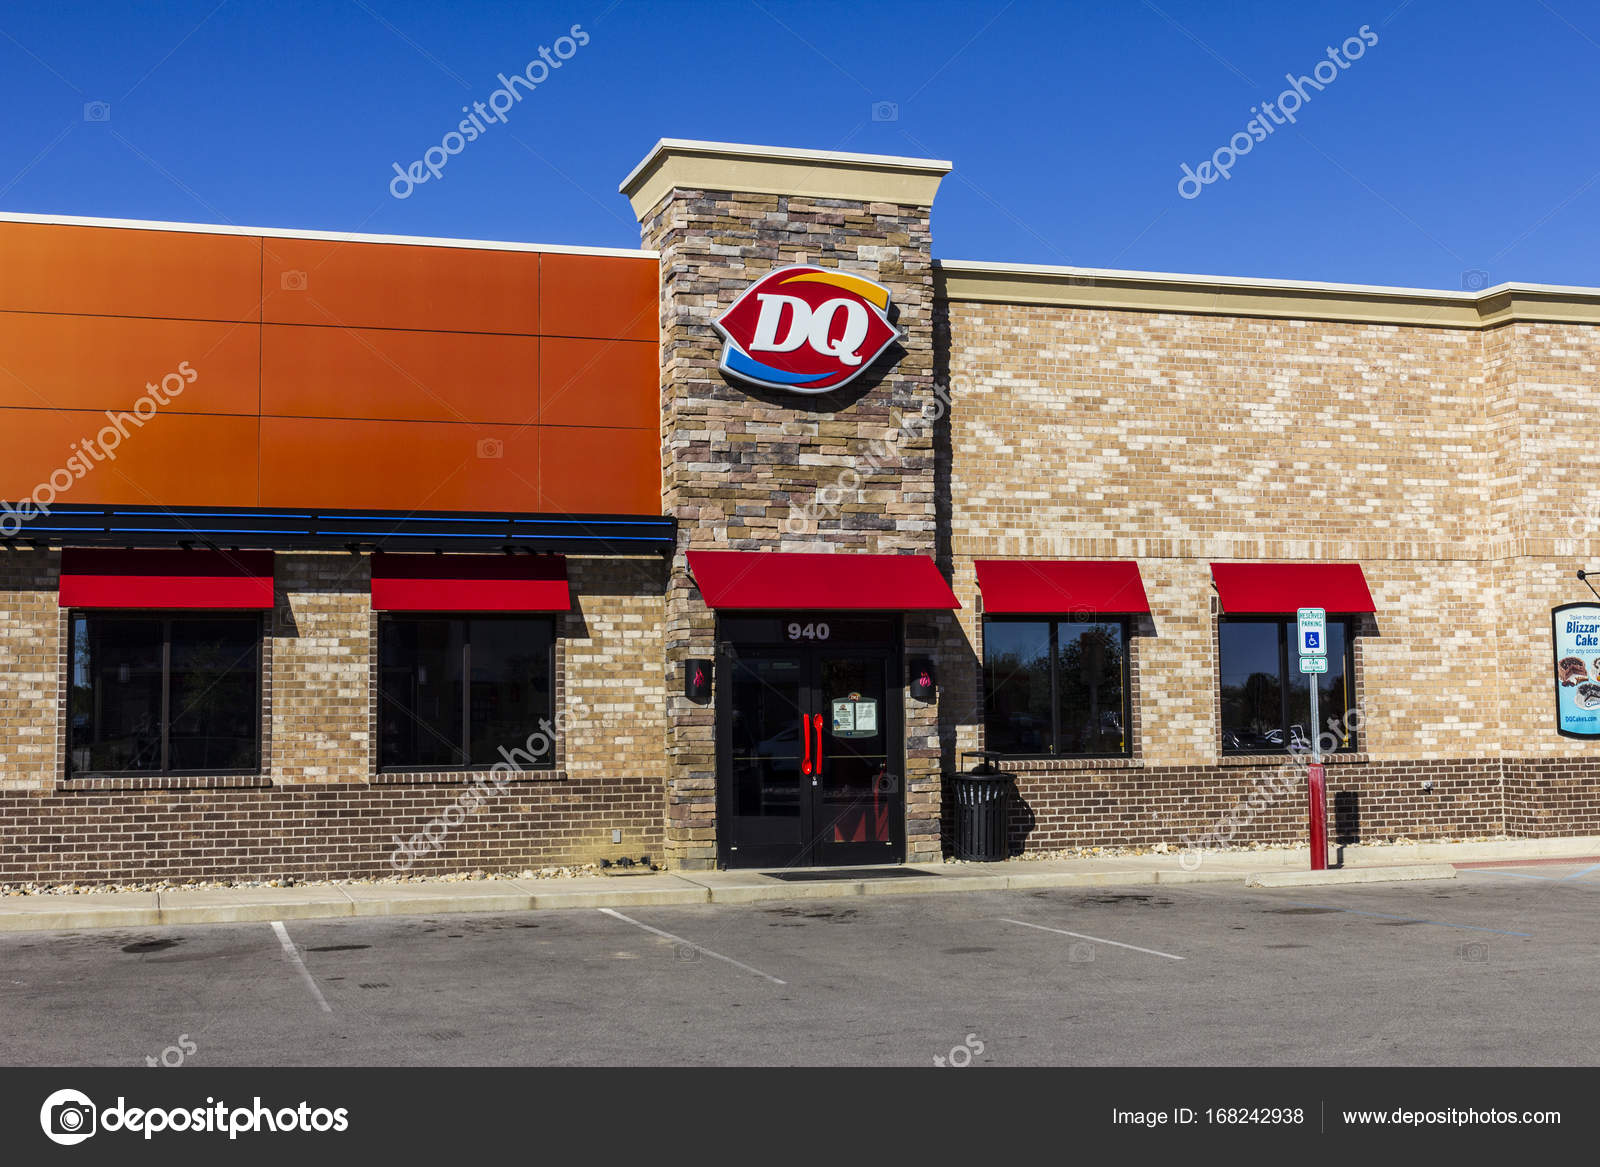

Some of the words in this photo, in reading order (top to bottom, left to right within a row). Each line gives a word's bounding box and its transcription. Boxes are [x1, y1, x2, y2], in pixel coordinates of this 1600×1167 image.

[749, 293, 869, 366] DQ
[787, 623, 830, 640] 940
[1576, 634, 1598, 646] Cake
